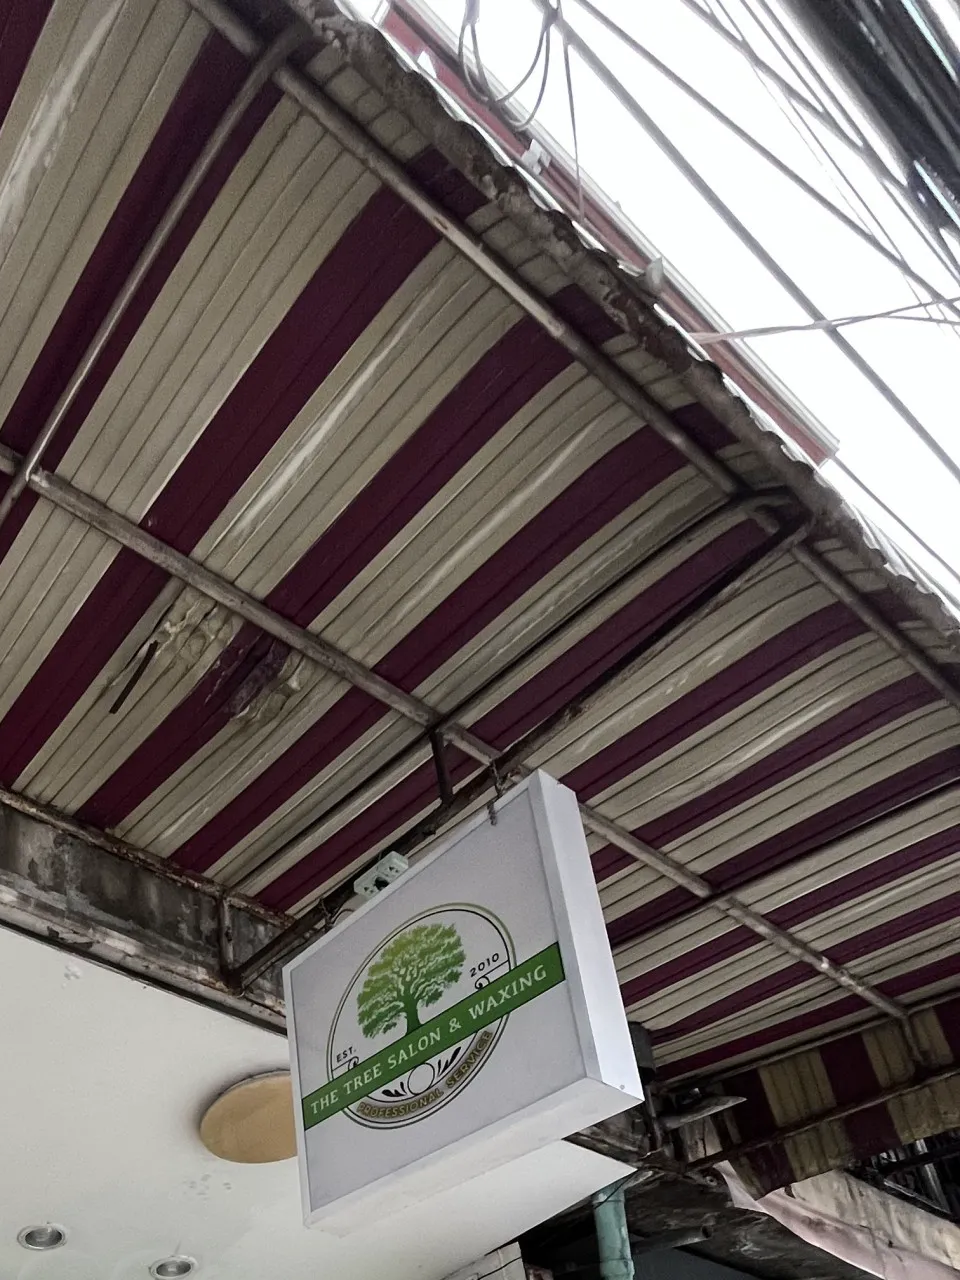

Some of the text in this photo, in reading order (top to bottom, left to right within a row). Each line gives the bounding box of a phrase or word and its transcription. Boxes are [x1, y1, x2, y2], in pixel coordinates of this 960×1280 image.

[470, 953, 499, 978] 2010
[311, 965, 547, 1114] THE TREE SALON & WAXING
[336, 1046, 357, 1063] EST.
[356, 1030, 494, 1118] PROFESSIONAL SERVICE
